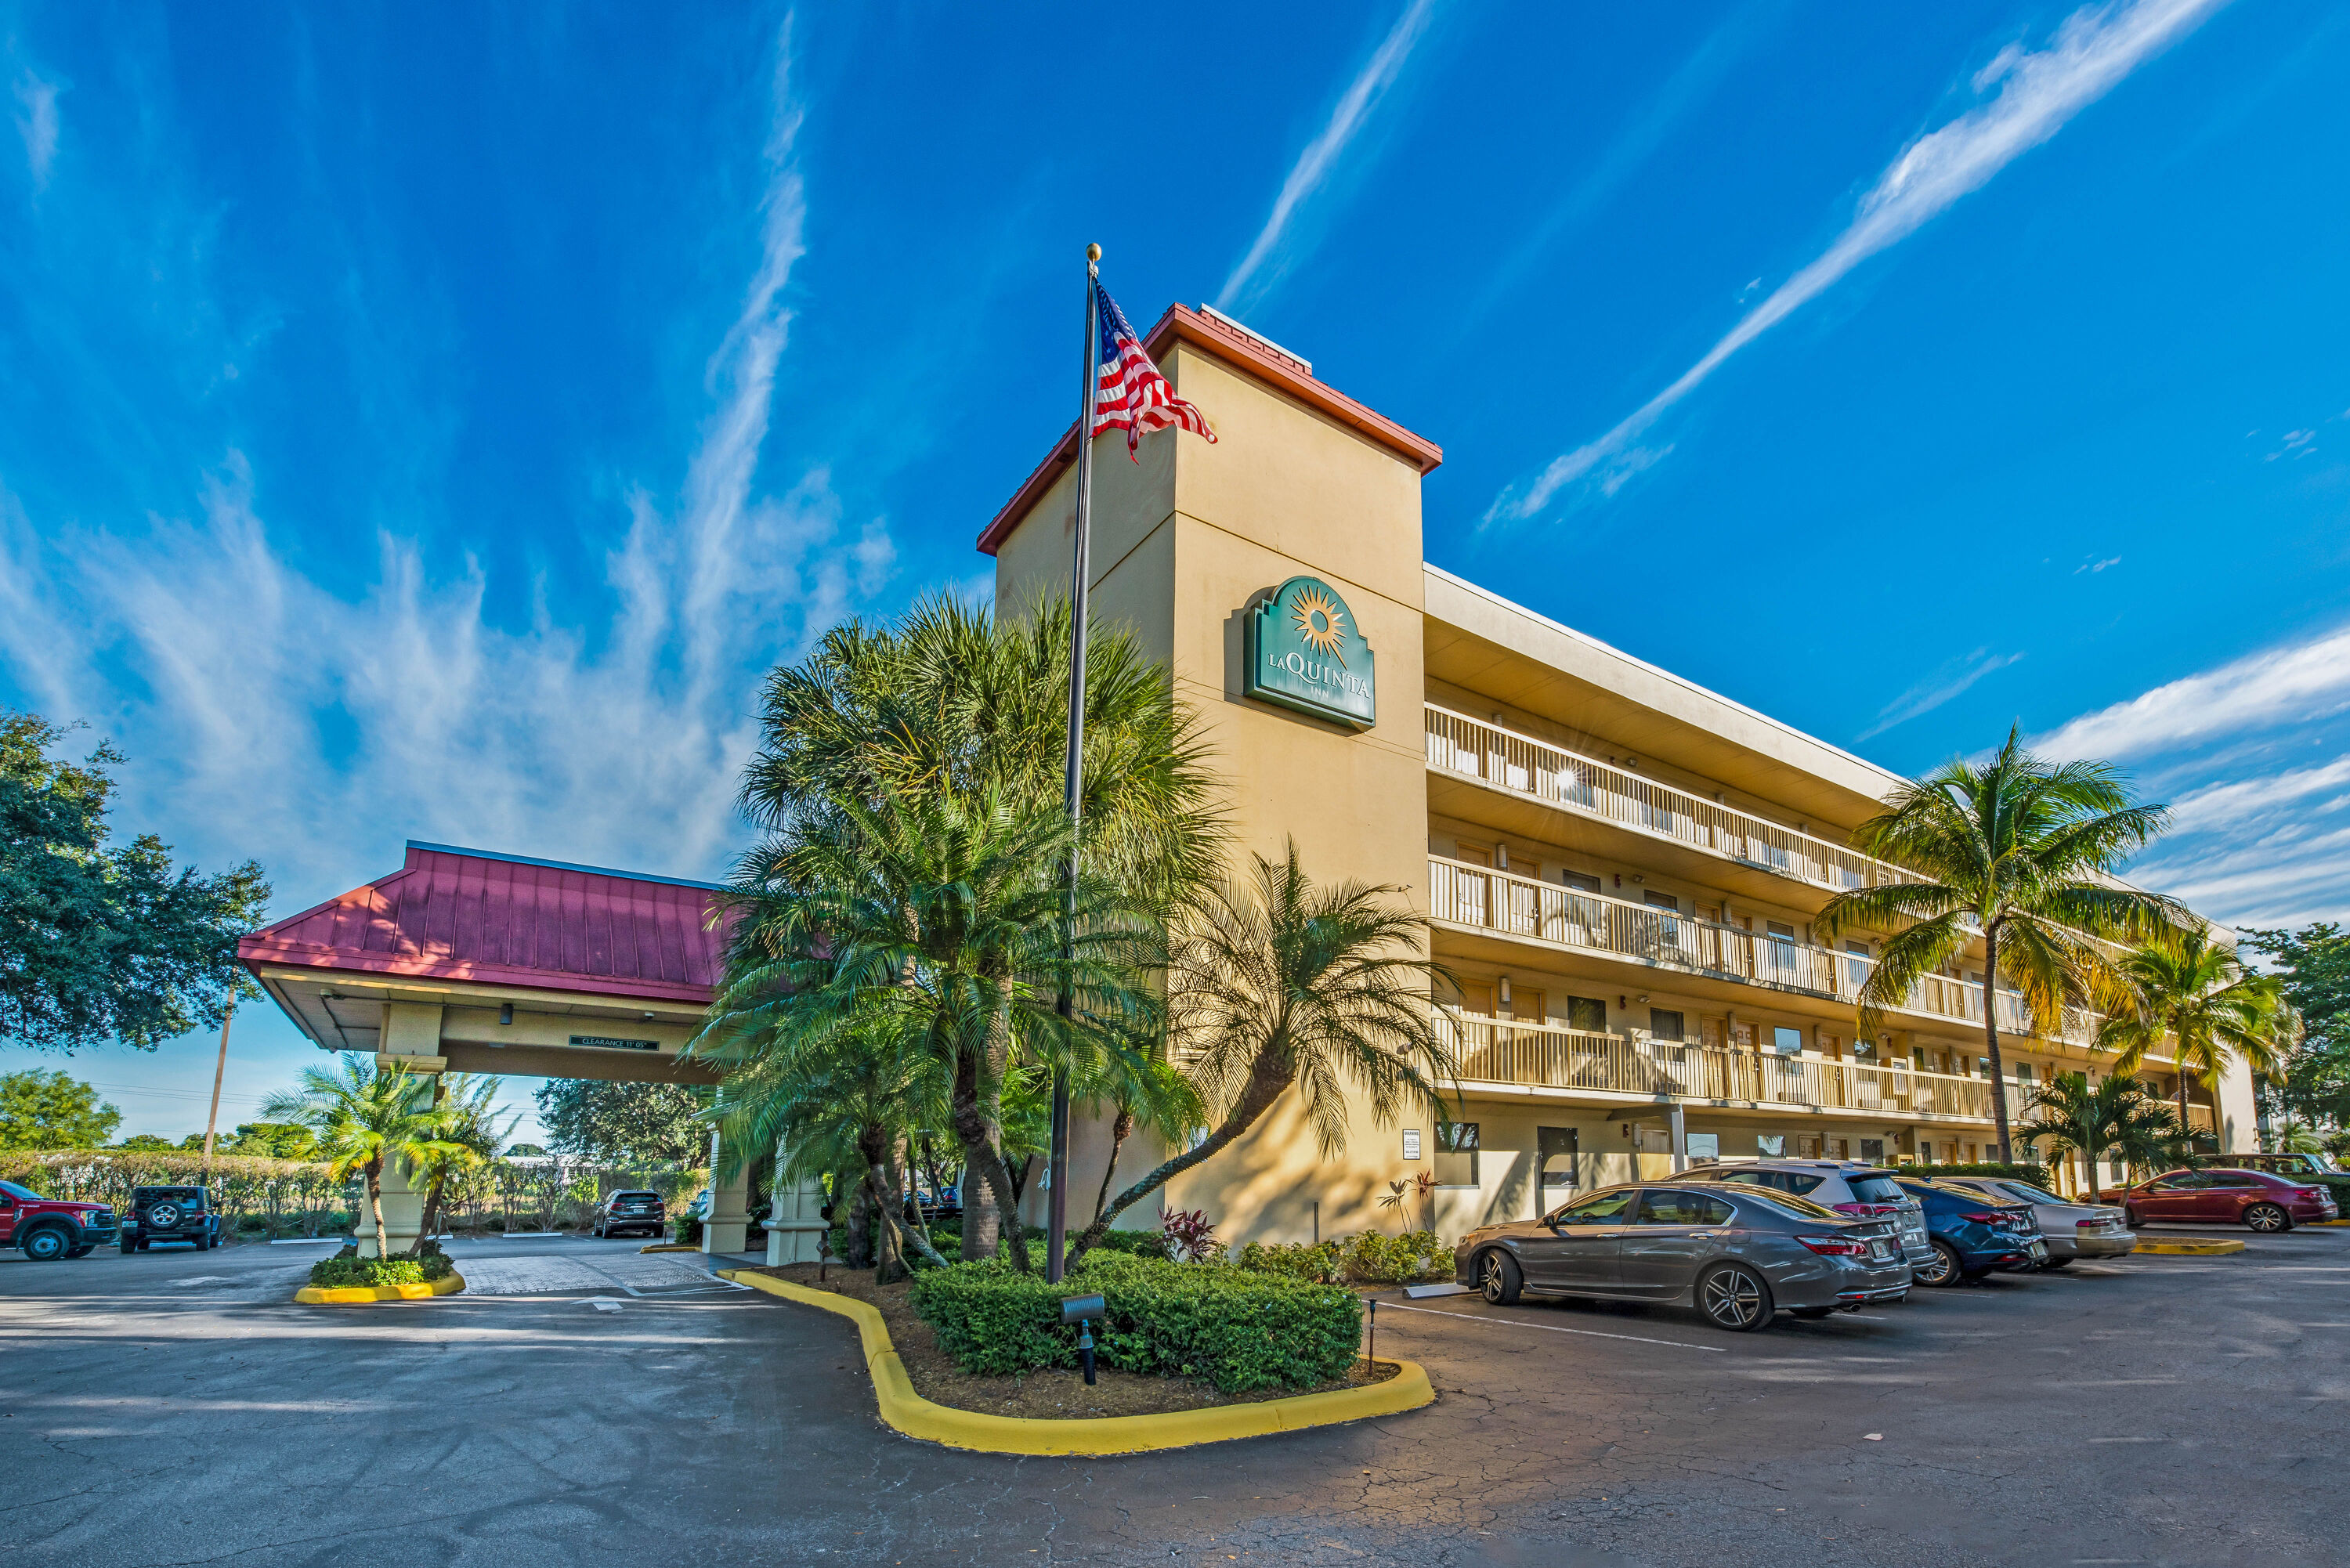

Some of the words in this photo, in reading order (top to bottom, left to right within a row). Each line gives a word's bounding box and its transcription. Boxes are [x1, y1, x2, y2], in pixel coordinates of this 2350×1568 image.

[1268, 653, 1286, 671] LA
[1285, 652, 1371, 699] QUINTA
[1311, 685, 1329, 699] INN
[582, 1038, 624, 1047] CLEARANCE
